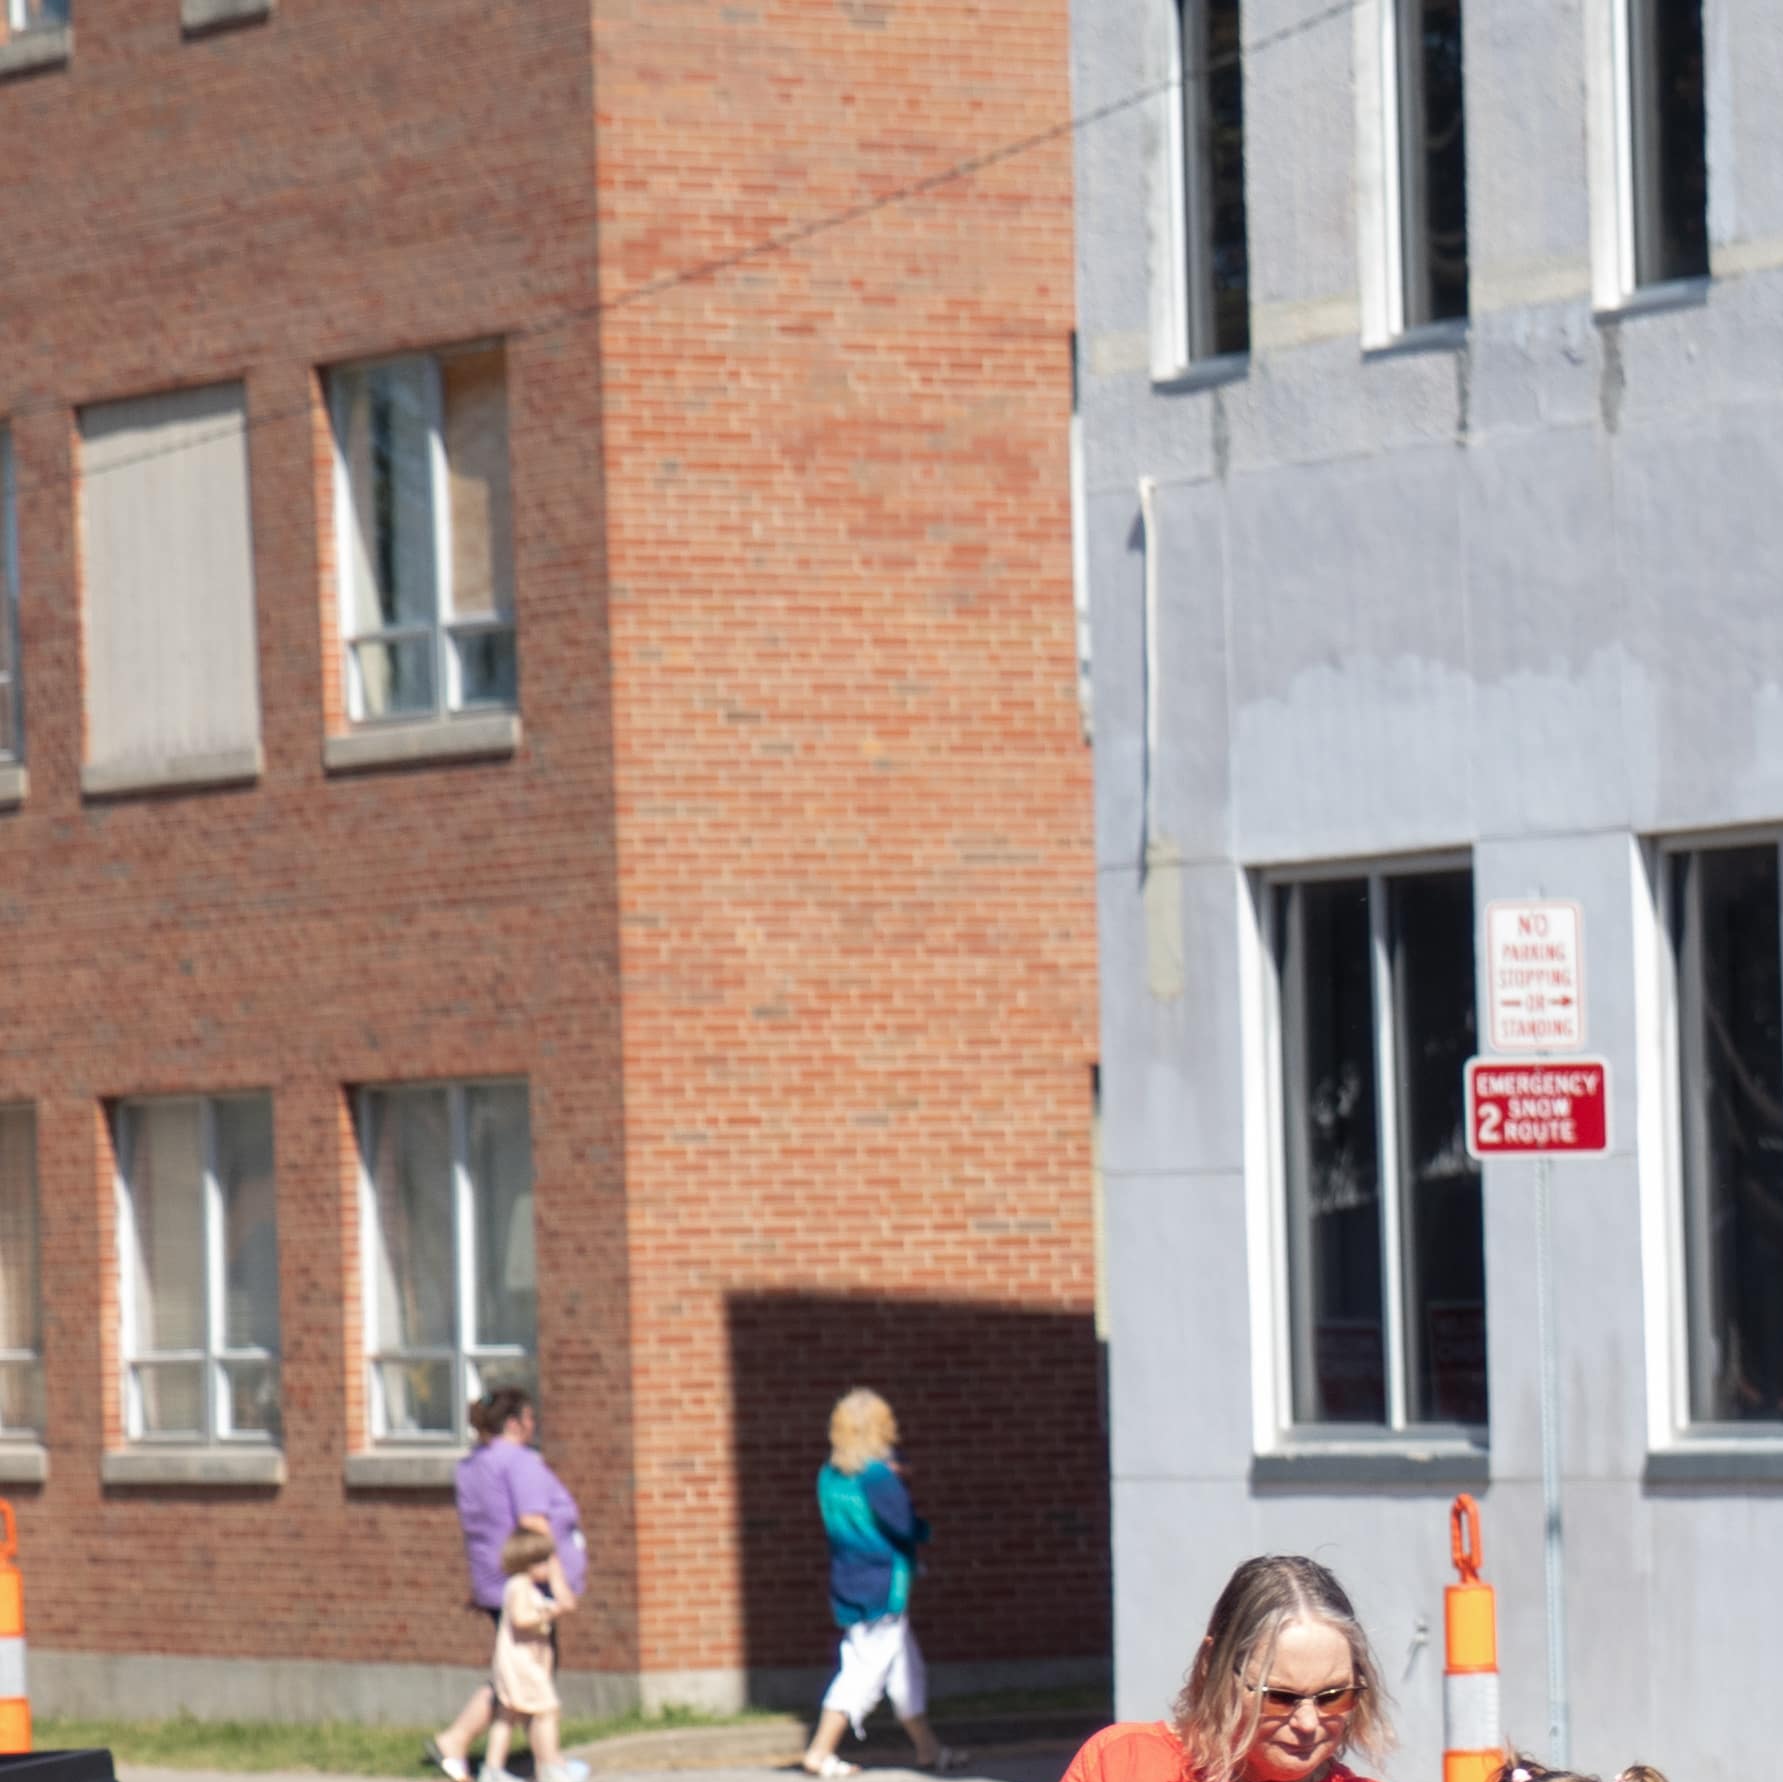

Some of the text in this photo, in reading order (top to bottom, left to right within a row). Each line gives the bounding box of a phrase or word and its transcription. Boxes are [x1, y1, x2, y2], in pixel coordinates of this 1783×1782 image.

[1518, 913, 1549, 935] NO
[1502, 943, 1566, 962] PARKING
[1500, 969, 1572, 988] STOPPING
[1526, 993, 1546, 1012] OR
[1501, 1019, 1573, 1038] STANDING
[1476, 1073, 1599, 1097] EMERGENCY
[1508, 1098, 1571, 1120] SNOW
[1477, 1102, 1502, 1145] 2
[1503, 1119, 1577, 1144] ROUTE
